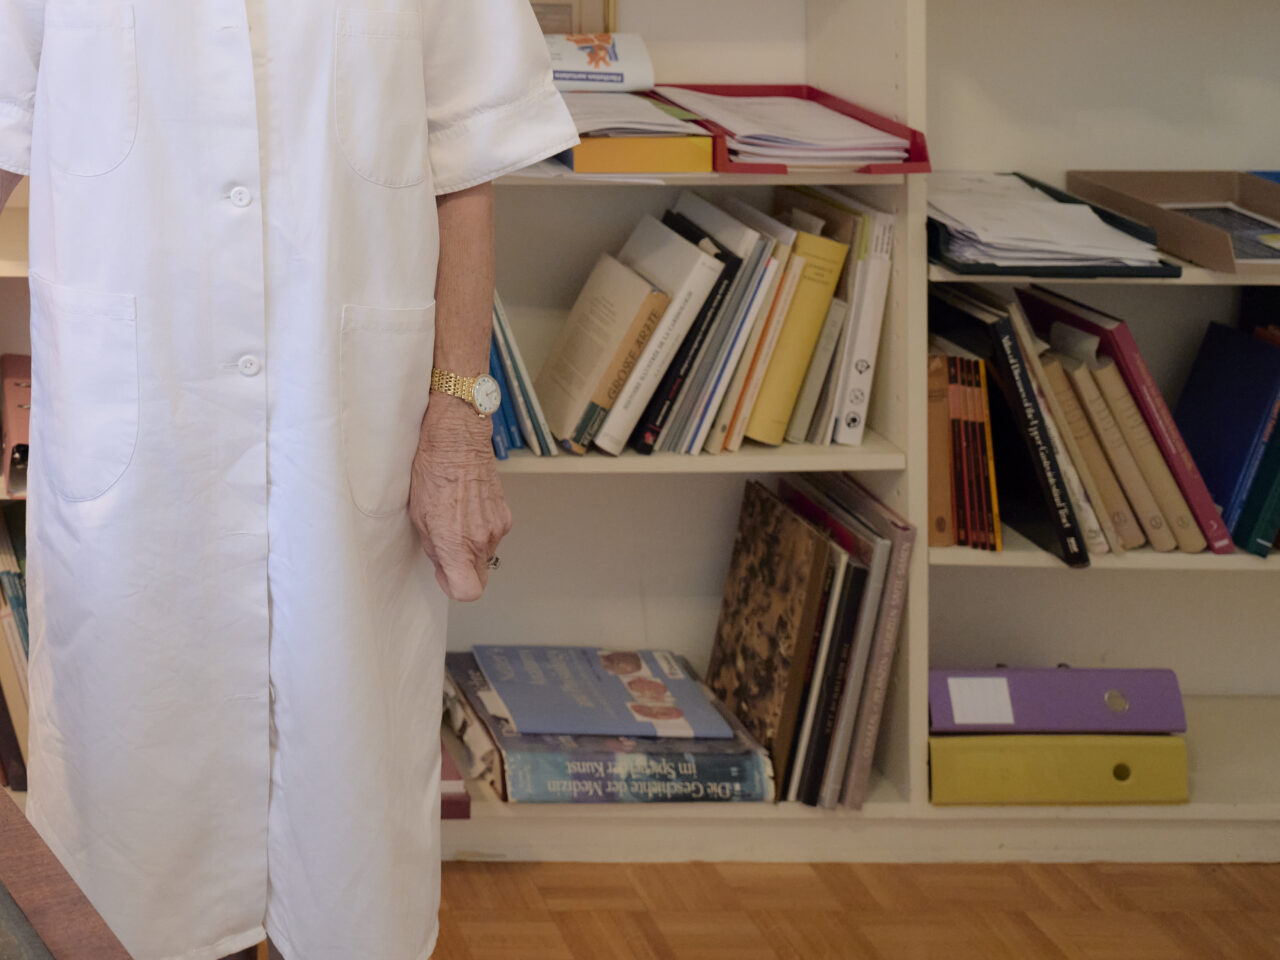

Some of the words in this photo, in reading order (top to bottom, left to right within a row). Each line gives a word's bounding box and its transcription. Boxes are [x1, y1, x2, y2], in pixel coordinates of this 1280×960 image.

[603, 348, 639, 402] GROSSE
[566, 761, 605, 779] Kunst
[677, 762, 697, 777] im
[547, 779, 602, 798] Medizin
[606, 780, 628, 797] der
[631, 780, 704, 799] Geschichte
[706, 782, 731, 798] Die
